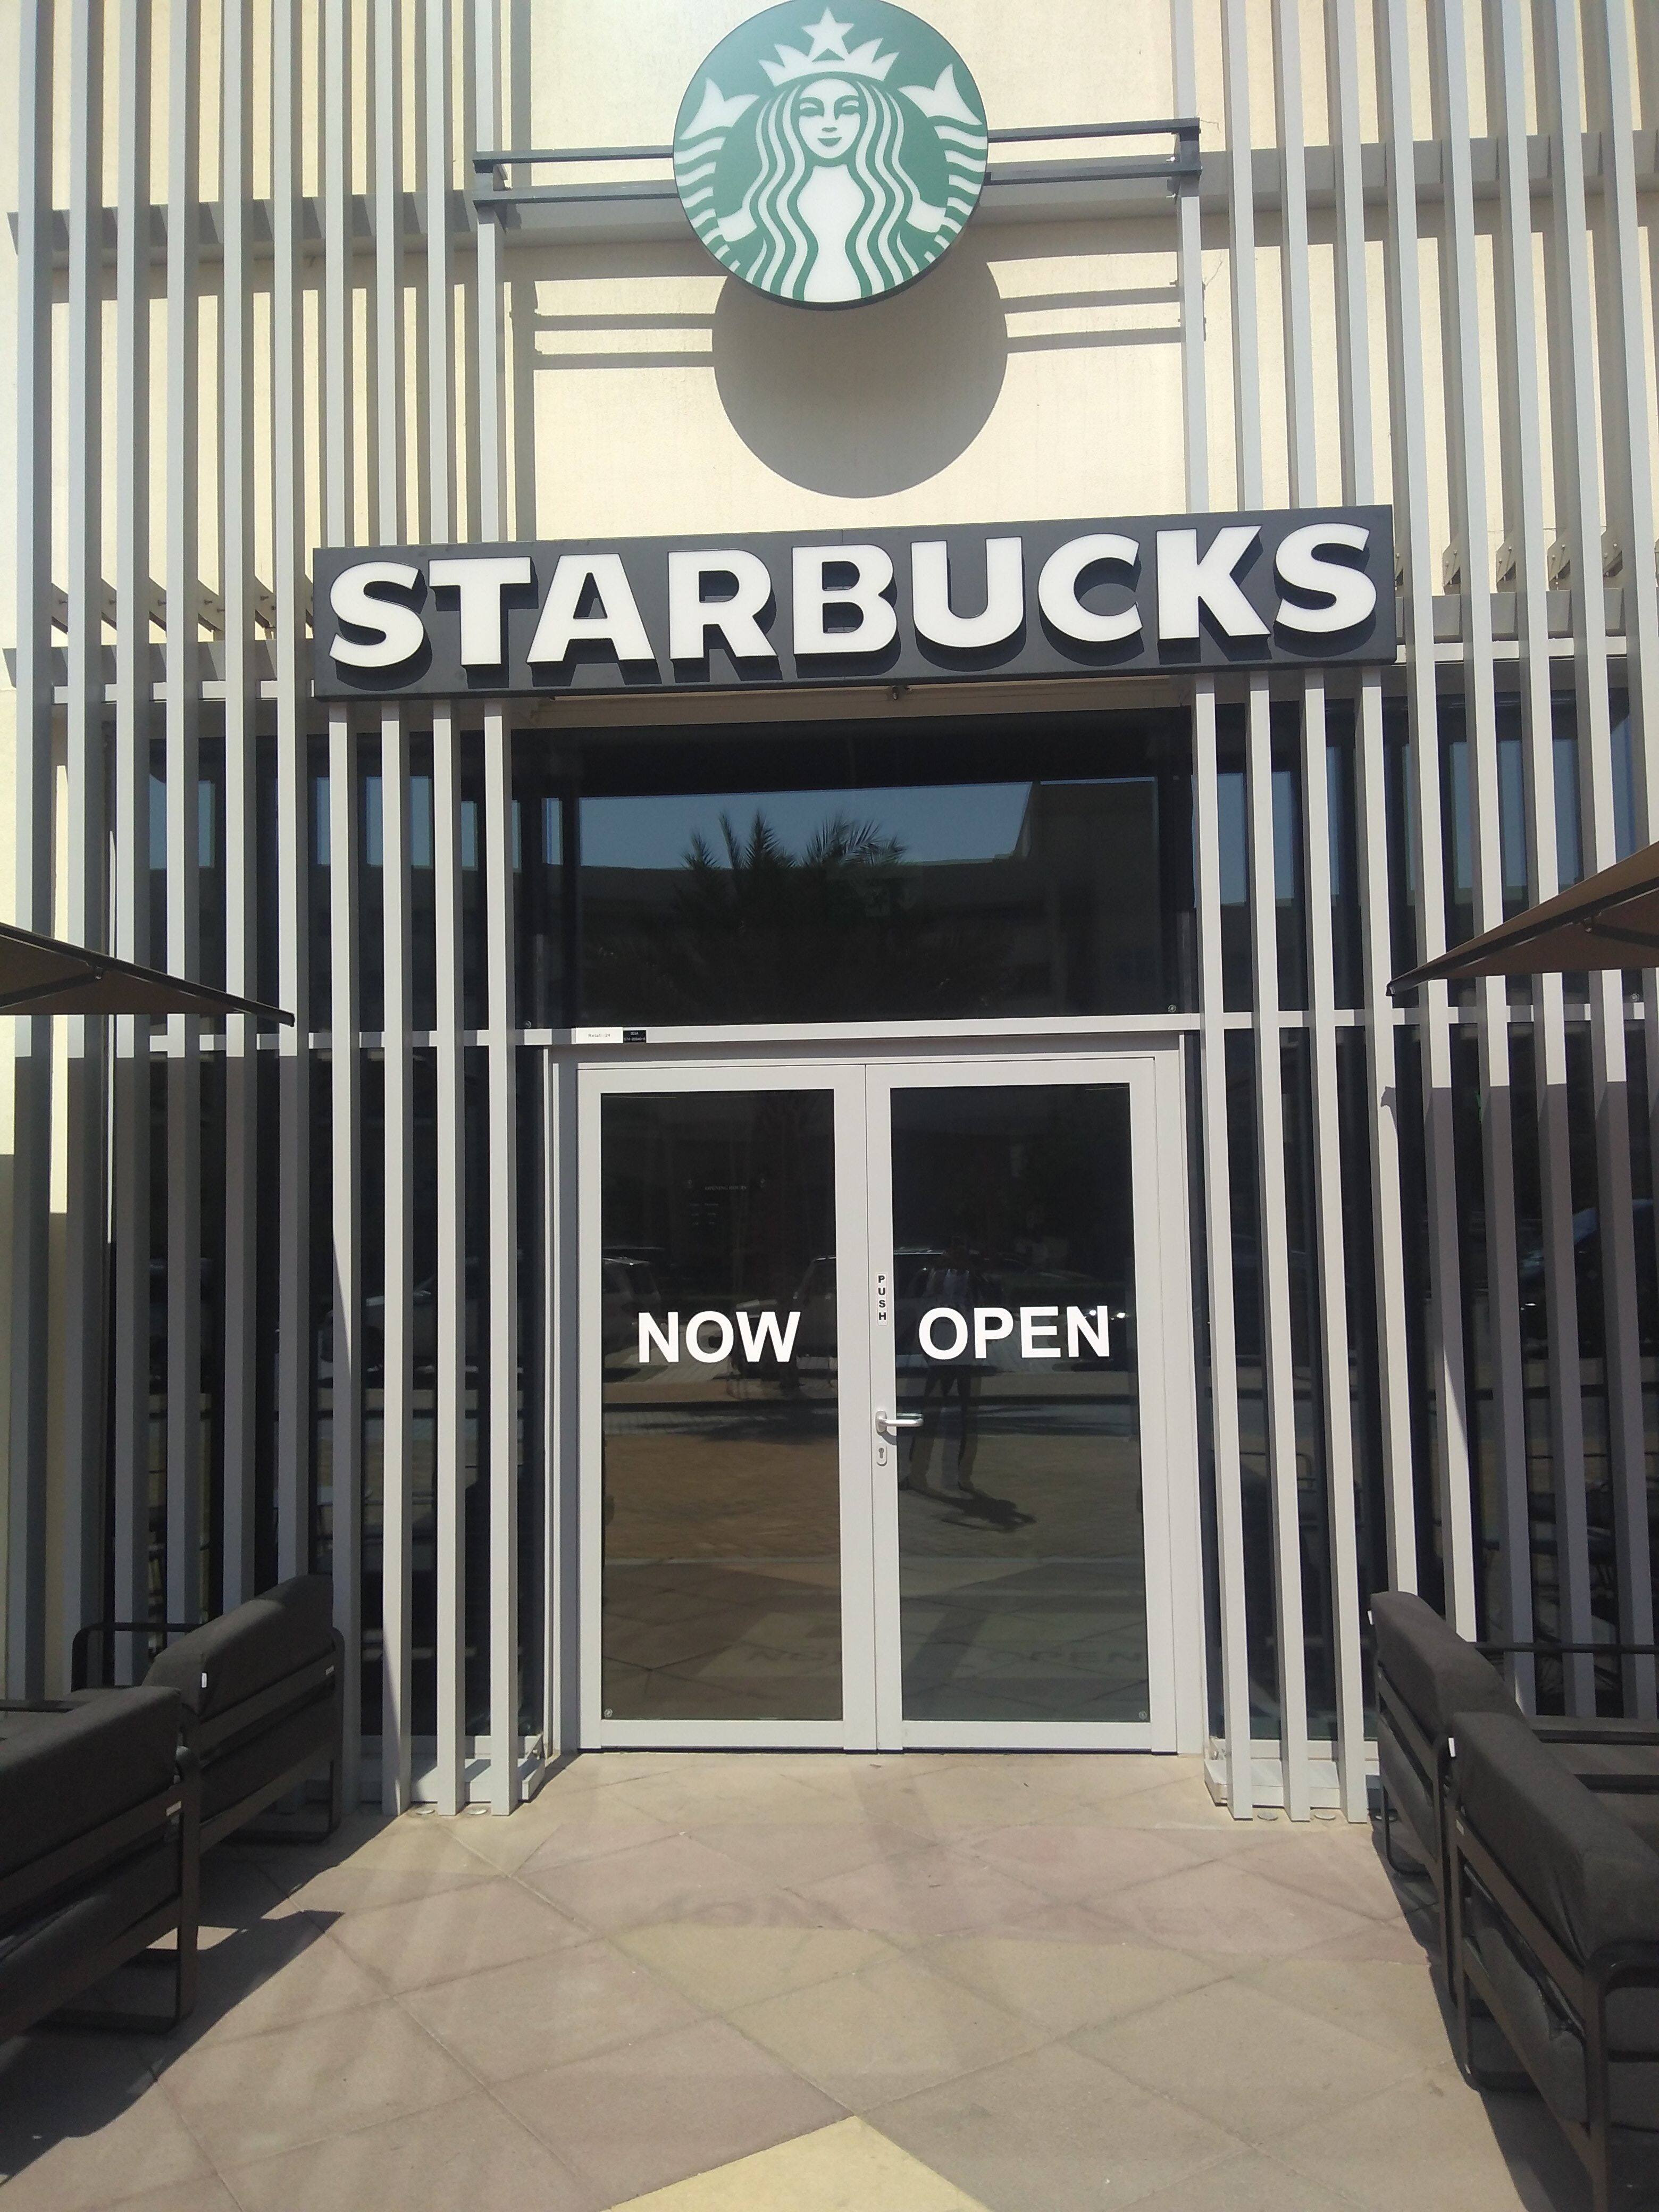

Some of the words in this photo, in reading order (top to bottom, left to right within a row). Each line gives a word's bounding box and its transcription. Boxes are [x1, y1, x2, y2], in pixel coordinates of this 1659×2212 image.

[329, 523, 1377, 668] STARBUCKS
[878, 1275, 886, 1320] PUSH
[639, 1311, 801, 1363] NOW
[919, 1305, 1110, 1360] OPEN
